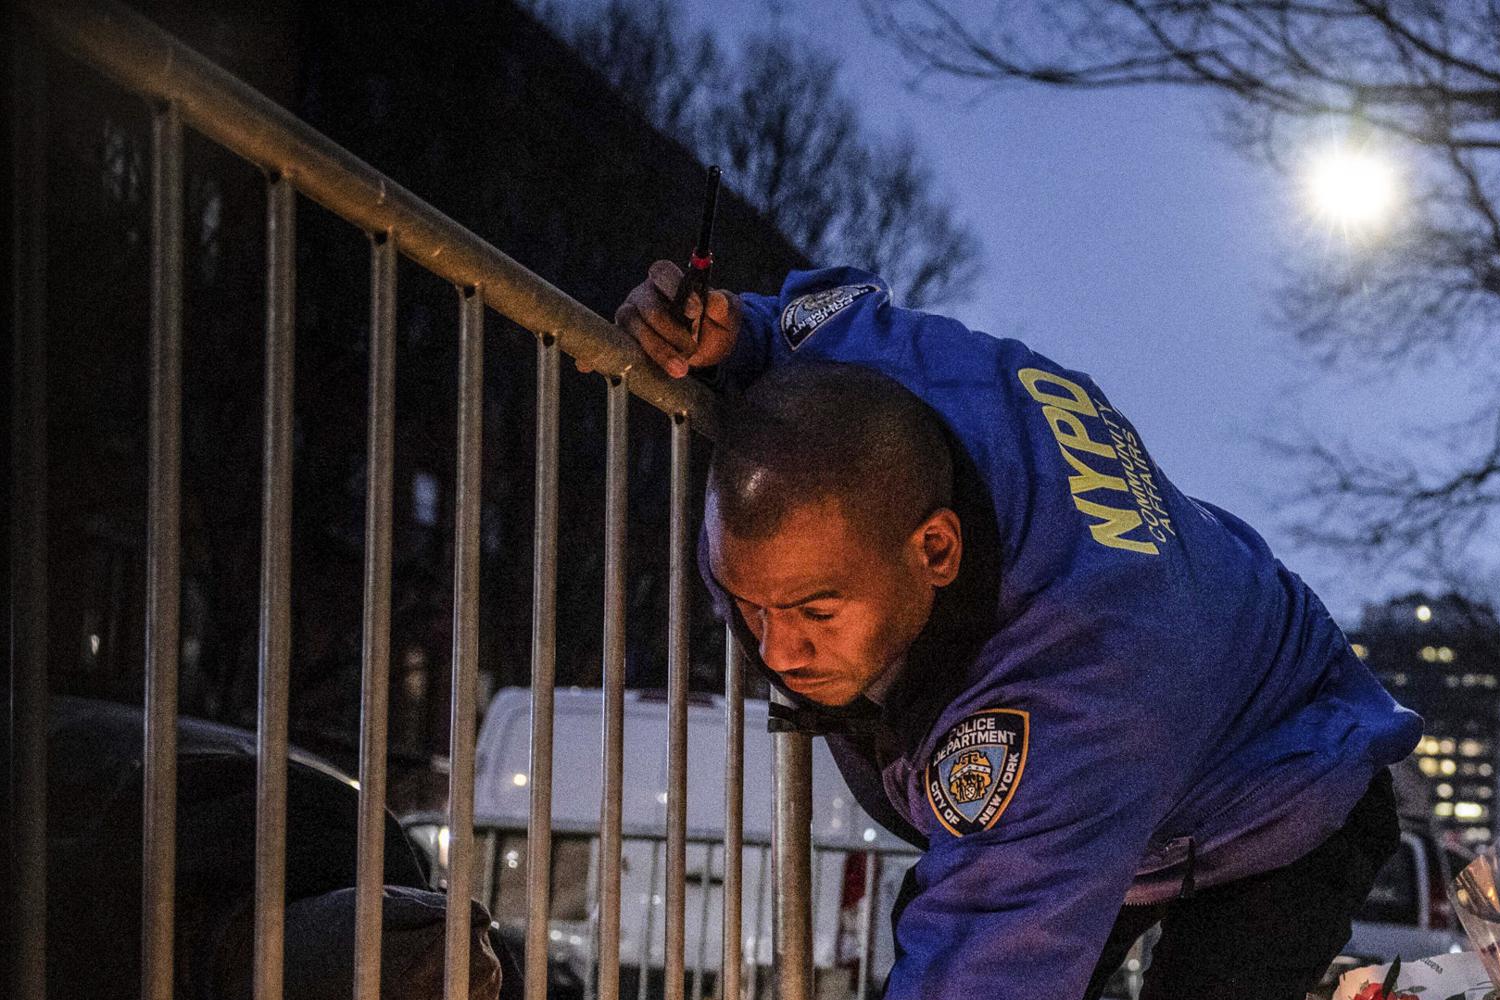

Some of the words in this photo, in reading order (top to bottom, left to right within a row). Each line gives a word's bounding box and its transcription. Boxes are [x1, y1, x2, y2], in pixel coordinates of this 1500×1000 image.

[1018, 368, 1160, 555] NYPD
[1093, 398, 1167, 543] COMMUNITY
[1122, 428, 1176, 536] AFFAIRS
[933, 730, 1016, 767] DEPARTMENT
[949, 717, 995, 740] POLICE
[931, 781, 947, 810] CITY
[944, 808, 960, 825] OF
[978, 794, 1002, 825] NEW
[997, 752, 1020, 793] YORK
